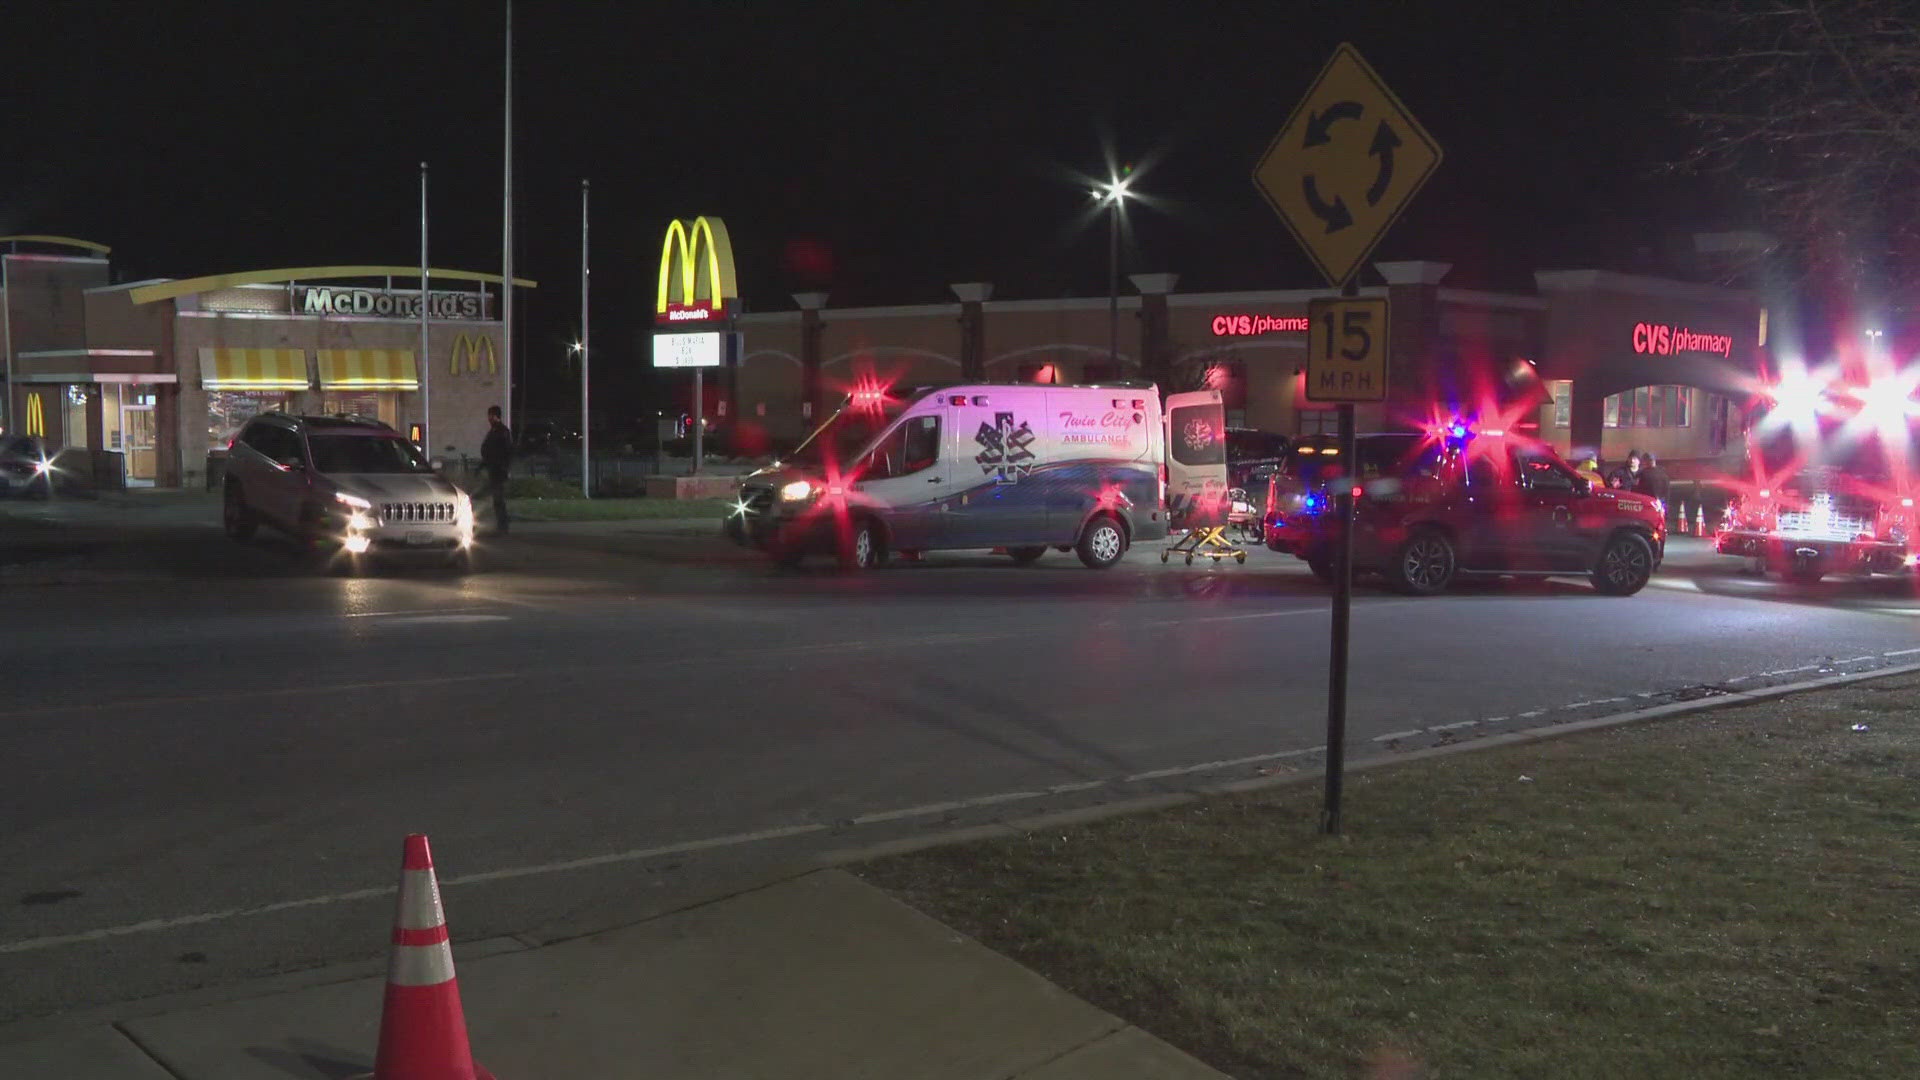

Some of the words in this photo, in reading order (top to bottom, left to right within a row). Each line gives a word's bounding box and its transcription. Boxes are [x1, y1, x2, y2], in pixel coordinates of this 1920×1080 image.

[303, 287, 478, 316] McDonald's
[669, 309, 708, 320] McDonald's
[1212, 315, 1308, 336] CVS/pharma
[1323, 310, 1372, 361] 15
[1632, 321, 1733, 359] CVS/pharmacy
[1059, 411, 1096, 429] Twin
[1101, 411, 1132, 431] City
[1063, 434, 1128, 443] AMBULANCE
